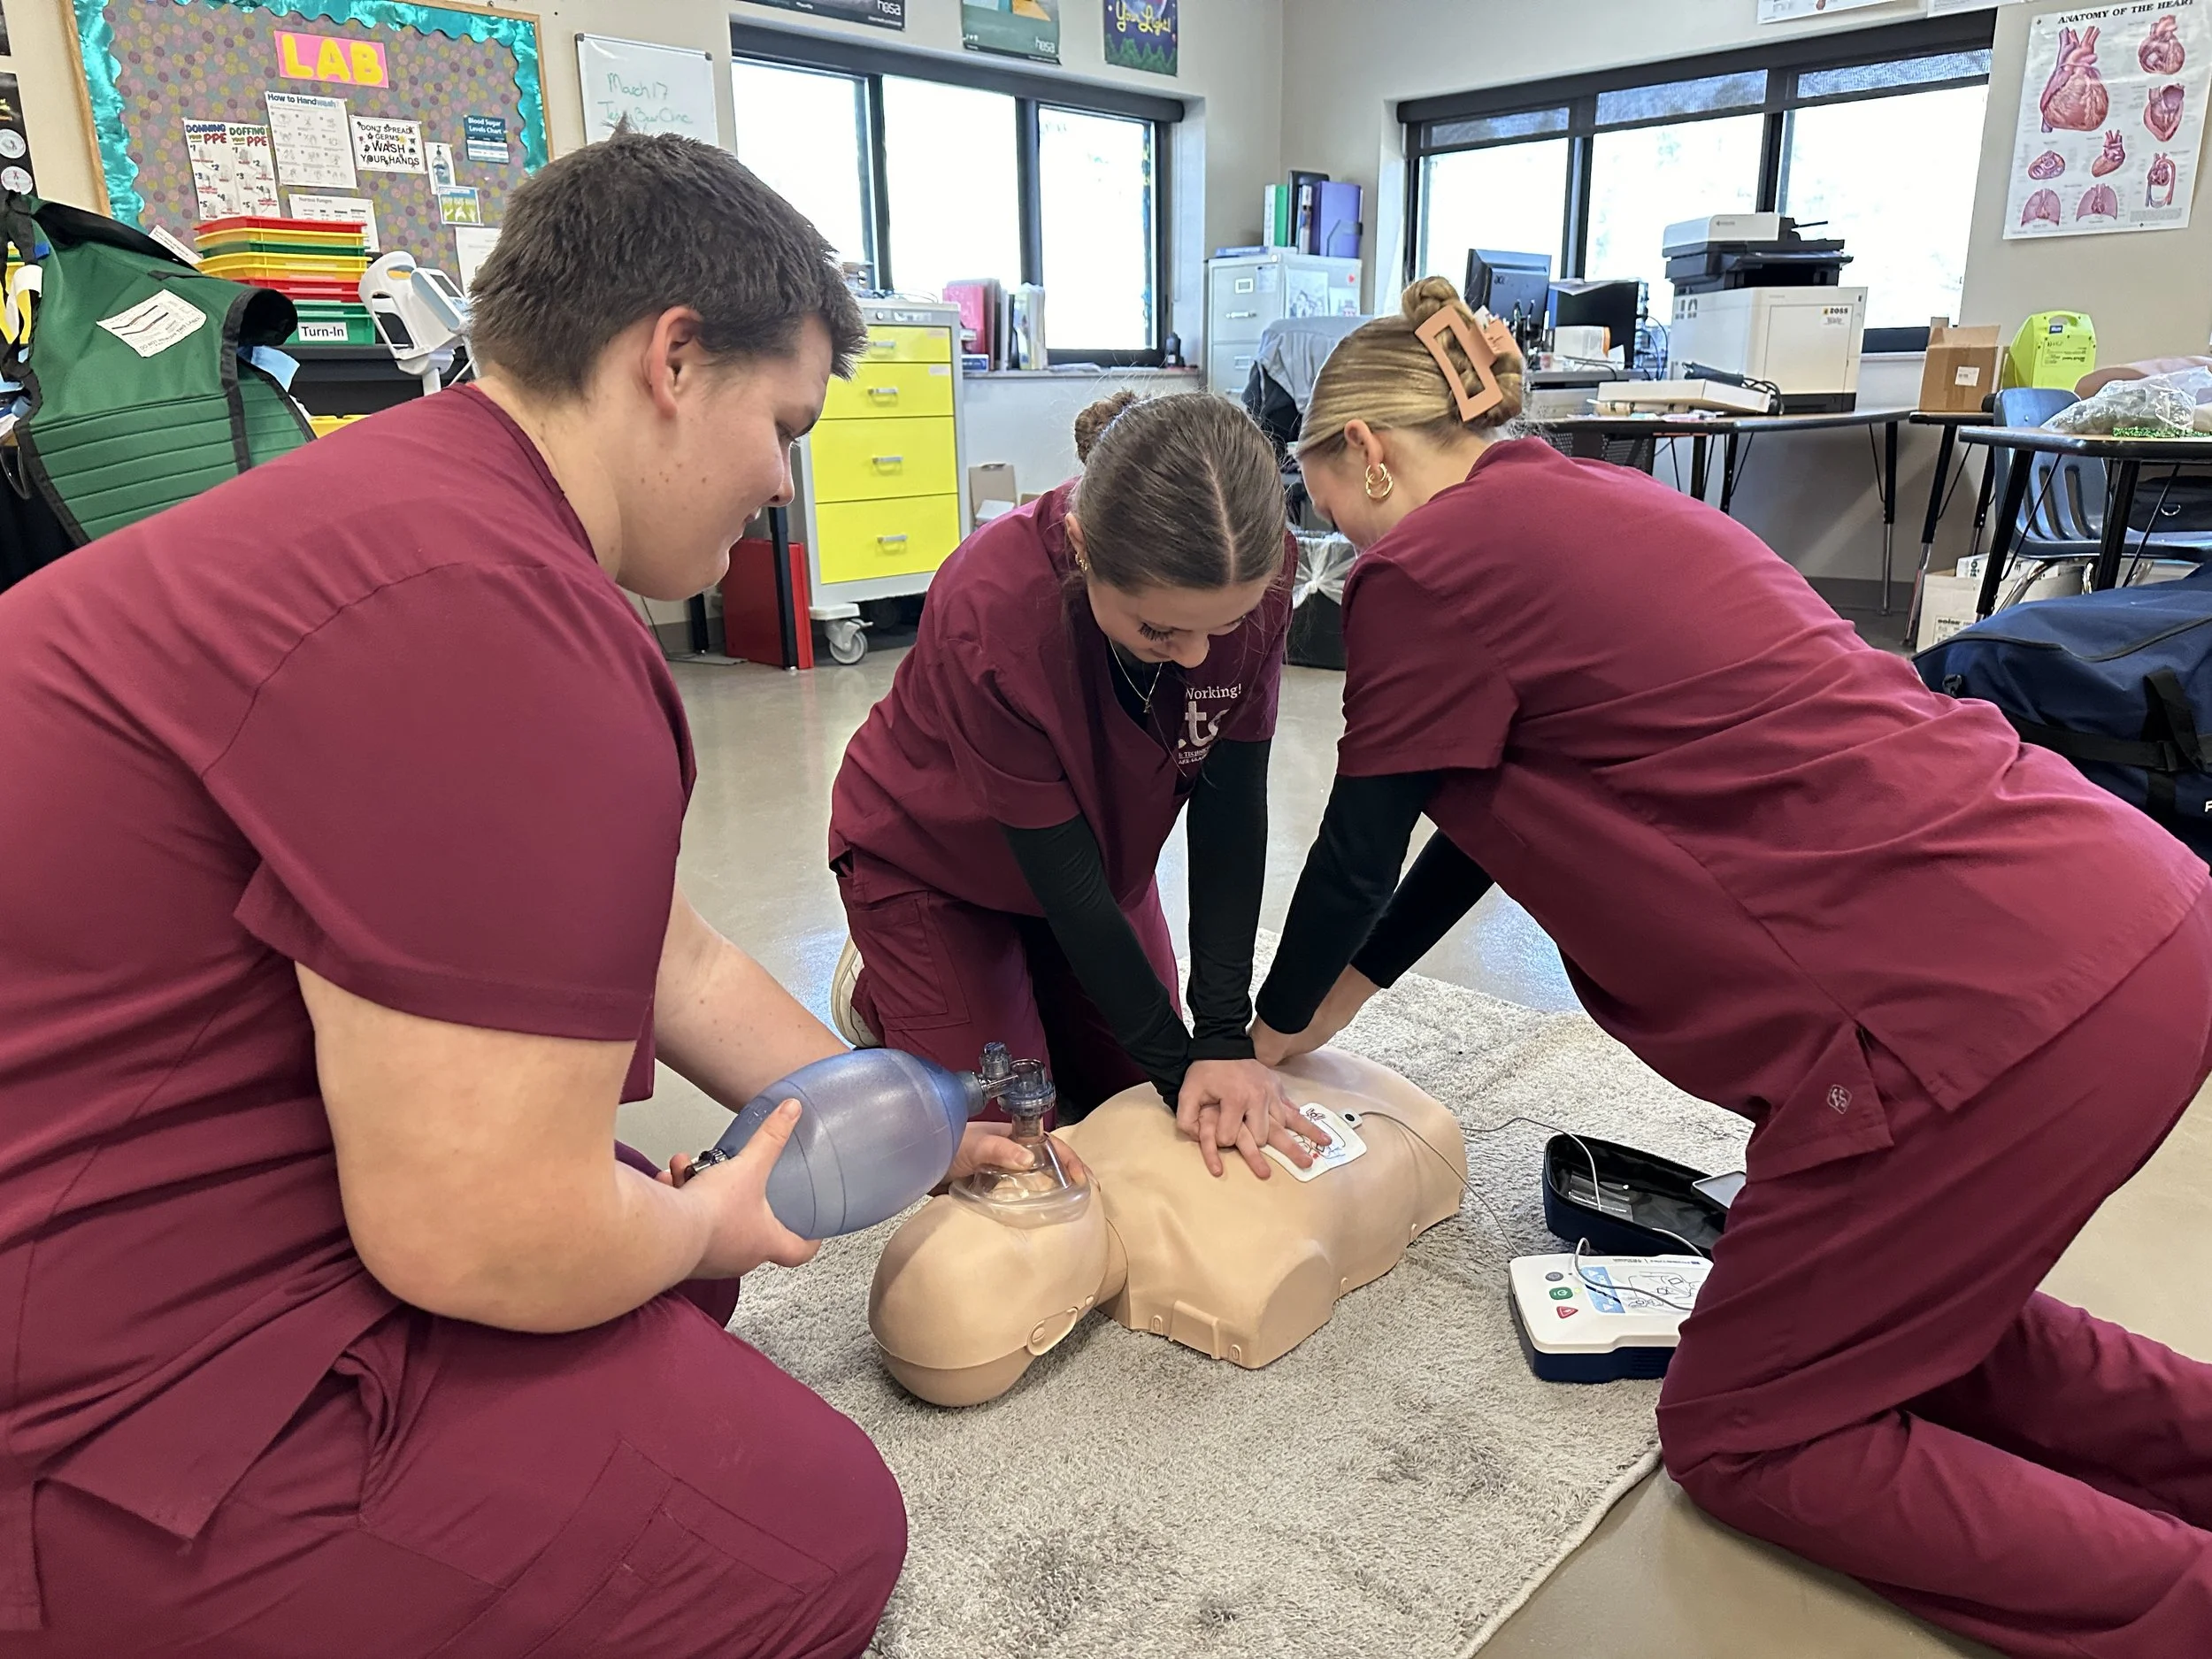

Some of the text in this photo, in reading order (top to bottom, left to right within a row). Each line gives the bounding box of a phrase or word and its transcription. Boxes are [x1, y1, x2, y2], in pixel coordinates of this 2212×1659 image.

[2057, 10, 2109, 25] ANATOMY
[2112, 7, 2127, 16] OF
[2131, 4, 2154, 14] THE
[281, 34, 384, 86] LAB
[607, 73, 651, 99] March
[267, 93, 285, 102] How
[287, 95, 296, 104] to
[185, 123, 227, 134] DONNING
[485, 119, 502, 127] Sugar
[229, 127, 265, 136] DOFFING
[383, 125, 412, 134] SPREAD
[204, 133, 227, 144] PPE
[246, 136, 268, 147] PPE
[374, 133, 400, 142] GERMS
[372, 142, 405, 154] WASH
[360, 154, 420, 166] YOUR HANDS
[301, 326, 344, 337] Turn-In
